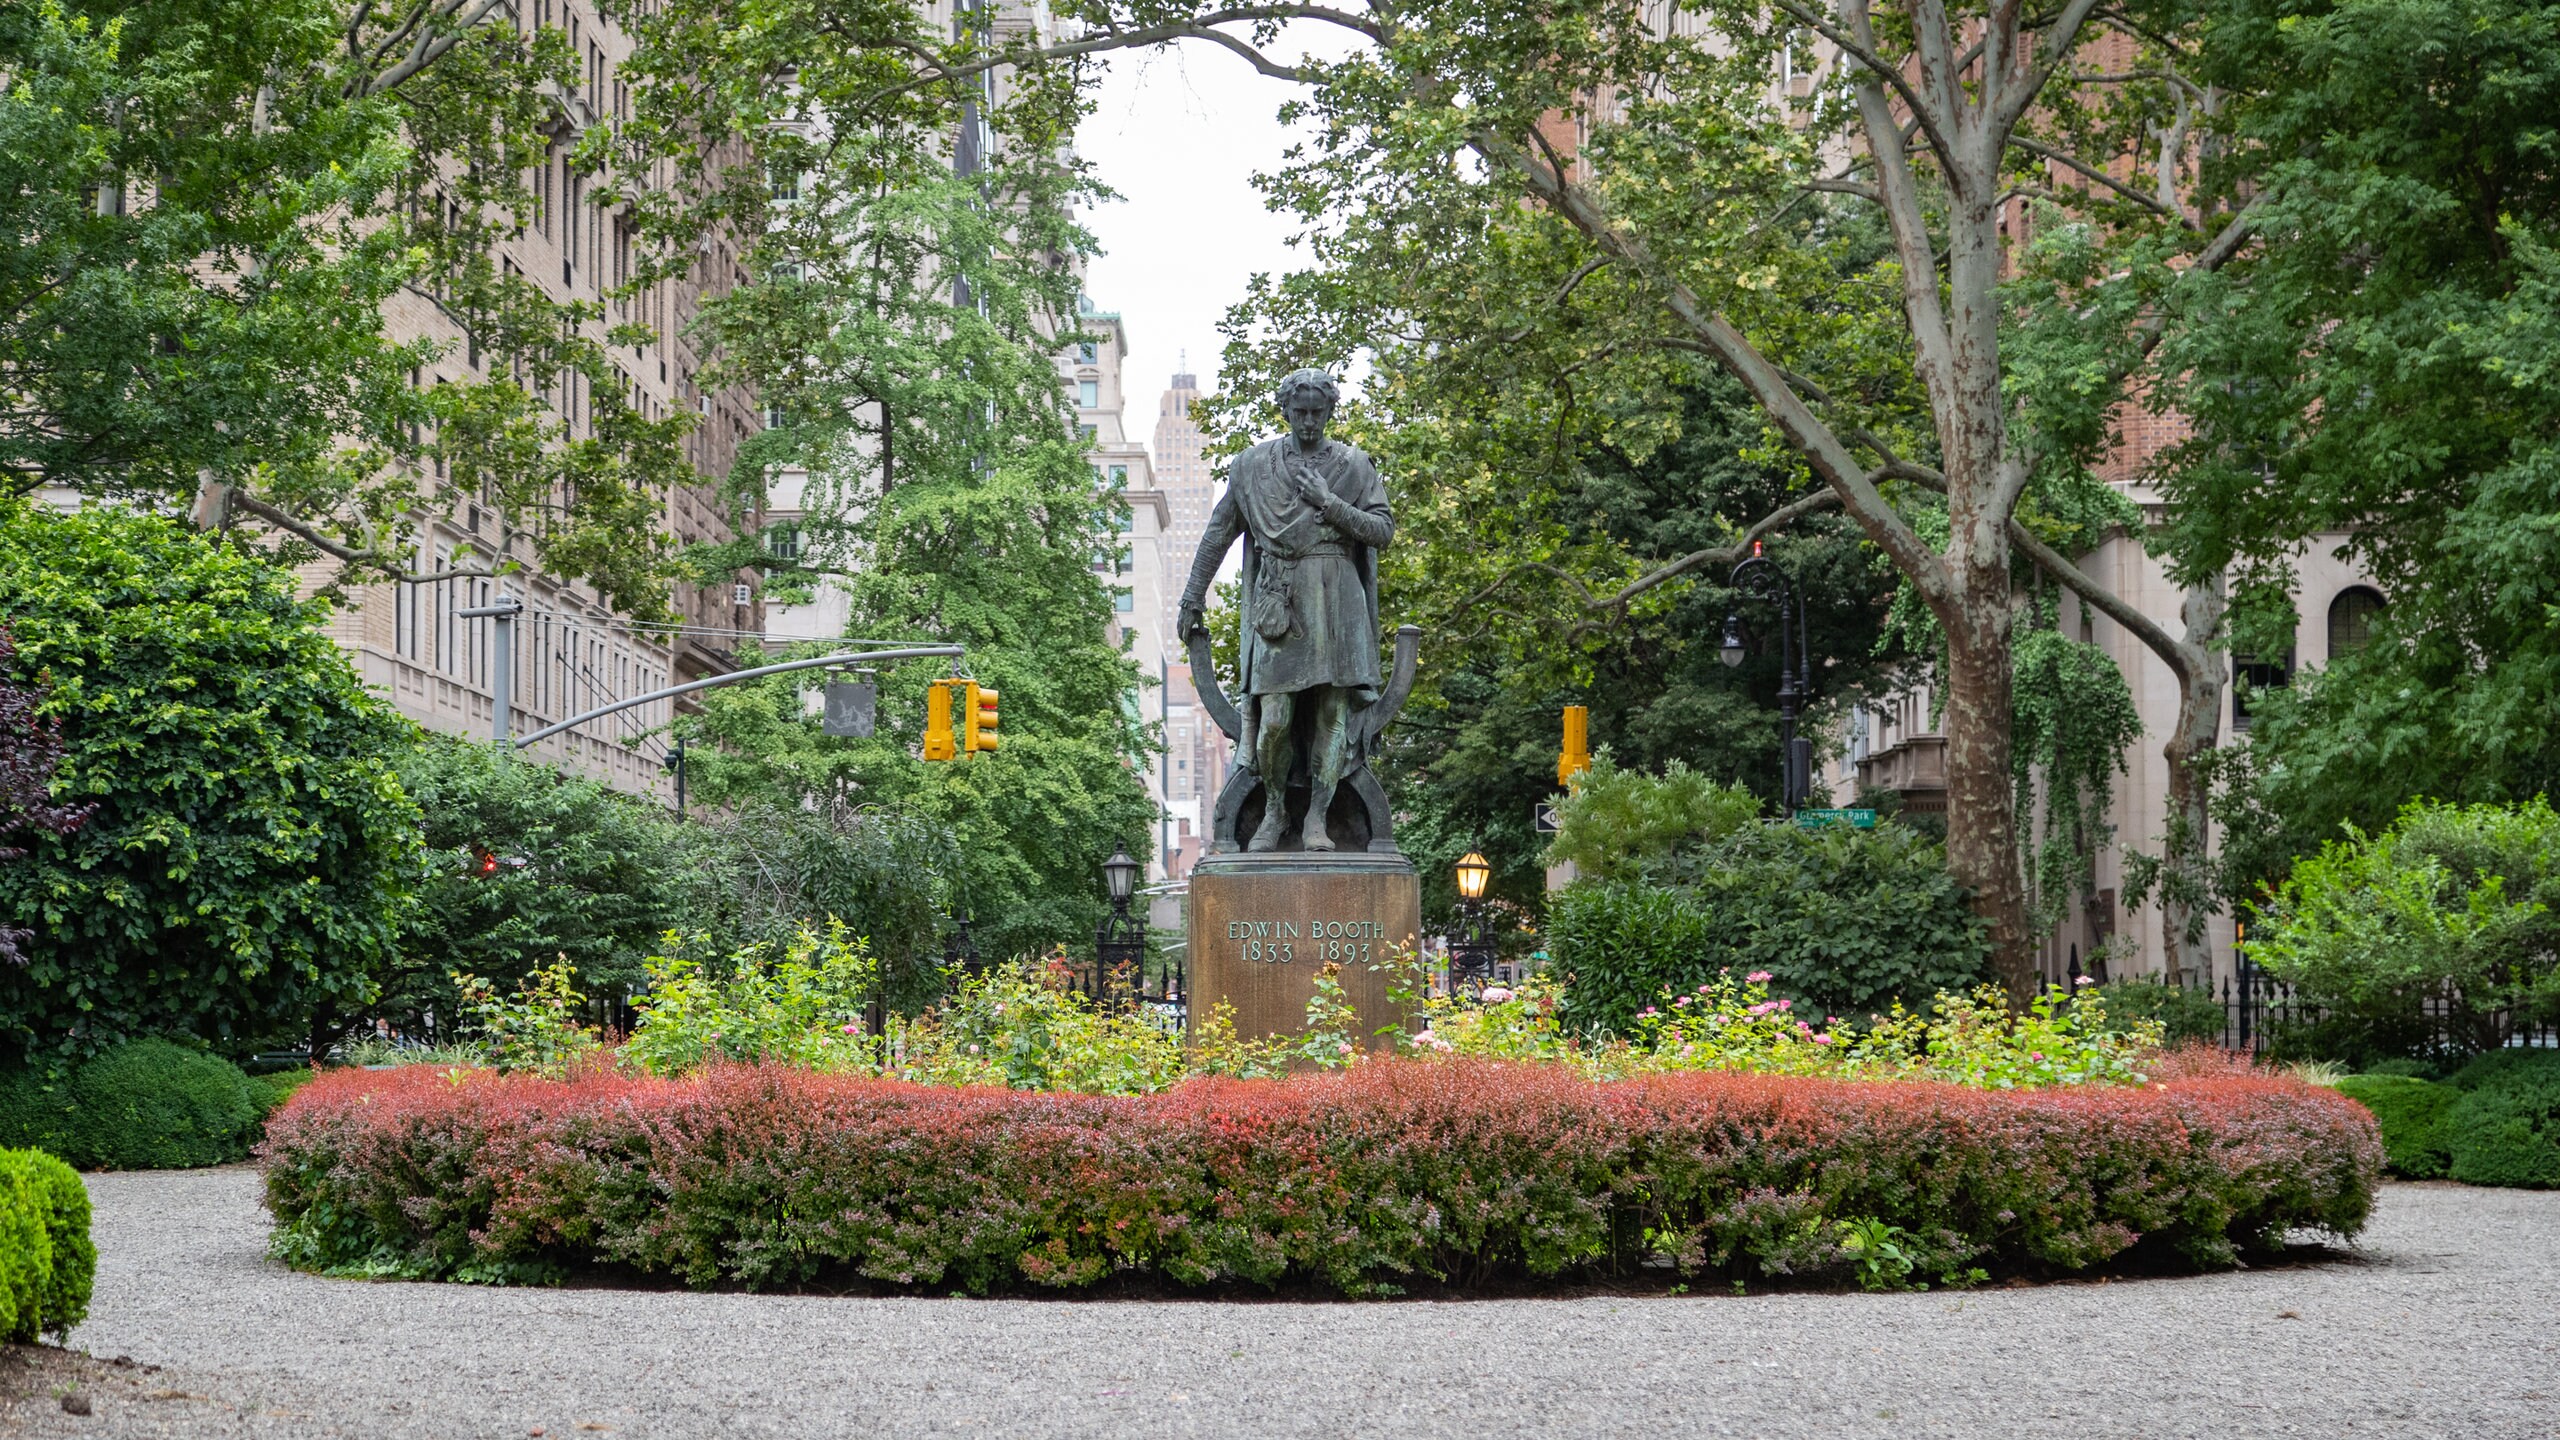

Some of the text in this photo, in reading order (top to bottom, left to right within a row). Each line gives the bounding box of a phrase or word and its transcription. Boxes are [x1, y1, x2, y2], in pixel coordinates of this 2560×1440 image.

[1848, 810, 1869, 821] Park
[1228, 921, 1384, 939] EDWIN BOOTH
[1241, 940, 1371, 965] 1833 1893
